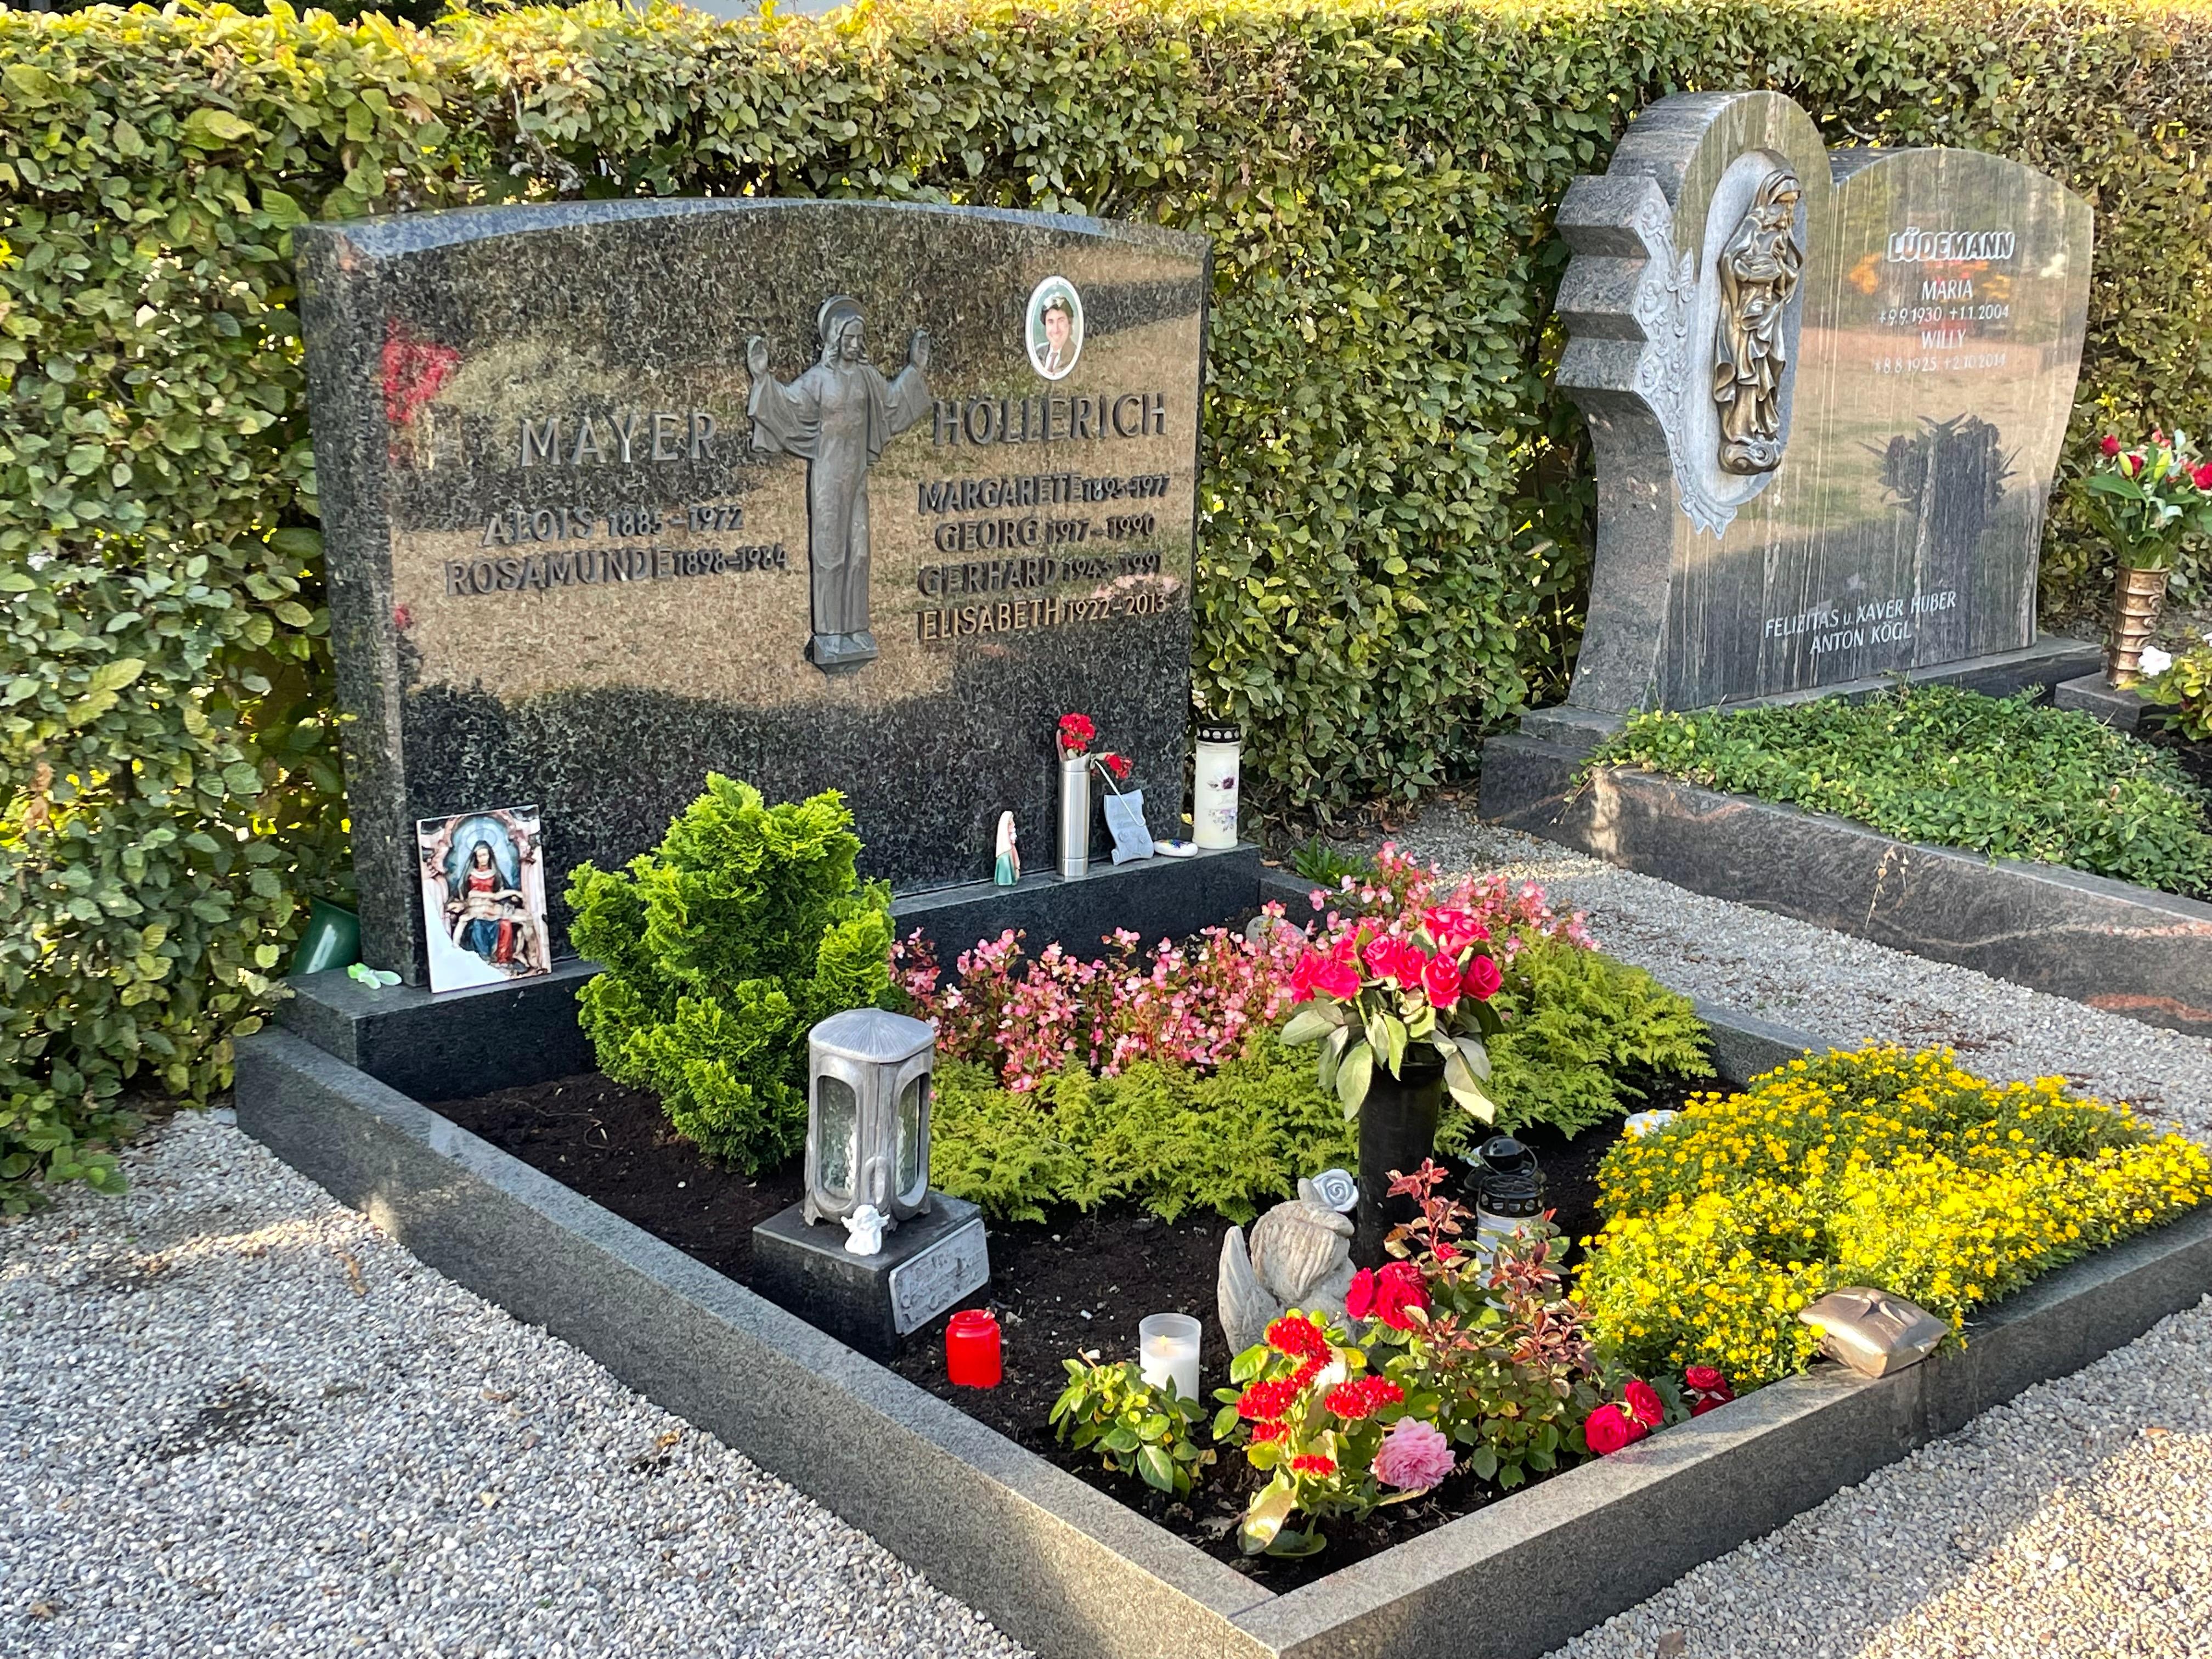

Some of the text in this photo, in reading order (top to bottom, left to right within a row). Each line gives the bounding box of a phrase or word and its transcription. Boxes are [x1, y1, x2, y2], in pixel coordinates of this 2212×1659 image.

[1888, 227, 2016, 262] LÜDEMANN
[1922, 279, 1973, 300] MARIA
[1922, 328, 1966, 349] WILLY
[520, 412, 716, 467] MAYER
[933, 393, 1167, 445] HÖLLERICH
[918, 472, 1082, 515] MARGARETE
[482, 505, 595, 546] ALOIS
[935, 517, 1041, 552] GEORG
[446, 547, 673, 596] ROSAMUNDE
[918, 557, 1058, 596] GERHARD
[918, 597, 1062, 641] ELISABETH
[1765, 610, 1839, 638] FELIZITAS
[1856, 599, 1904, 624] XAVER
[1910, 590, 1956, 614] HUBER
[1810, 619, 1912, 654] ANTON KÖGL
